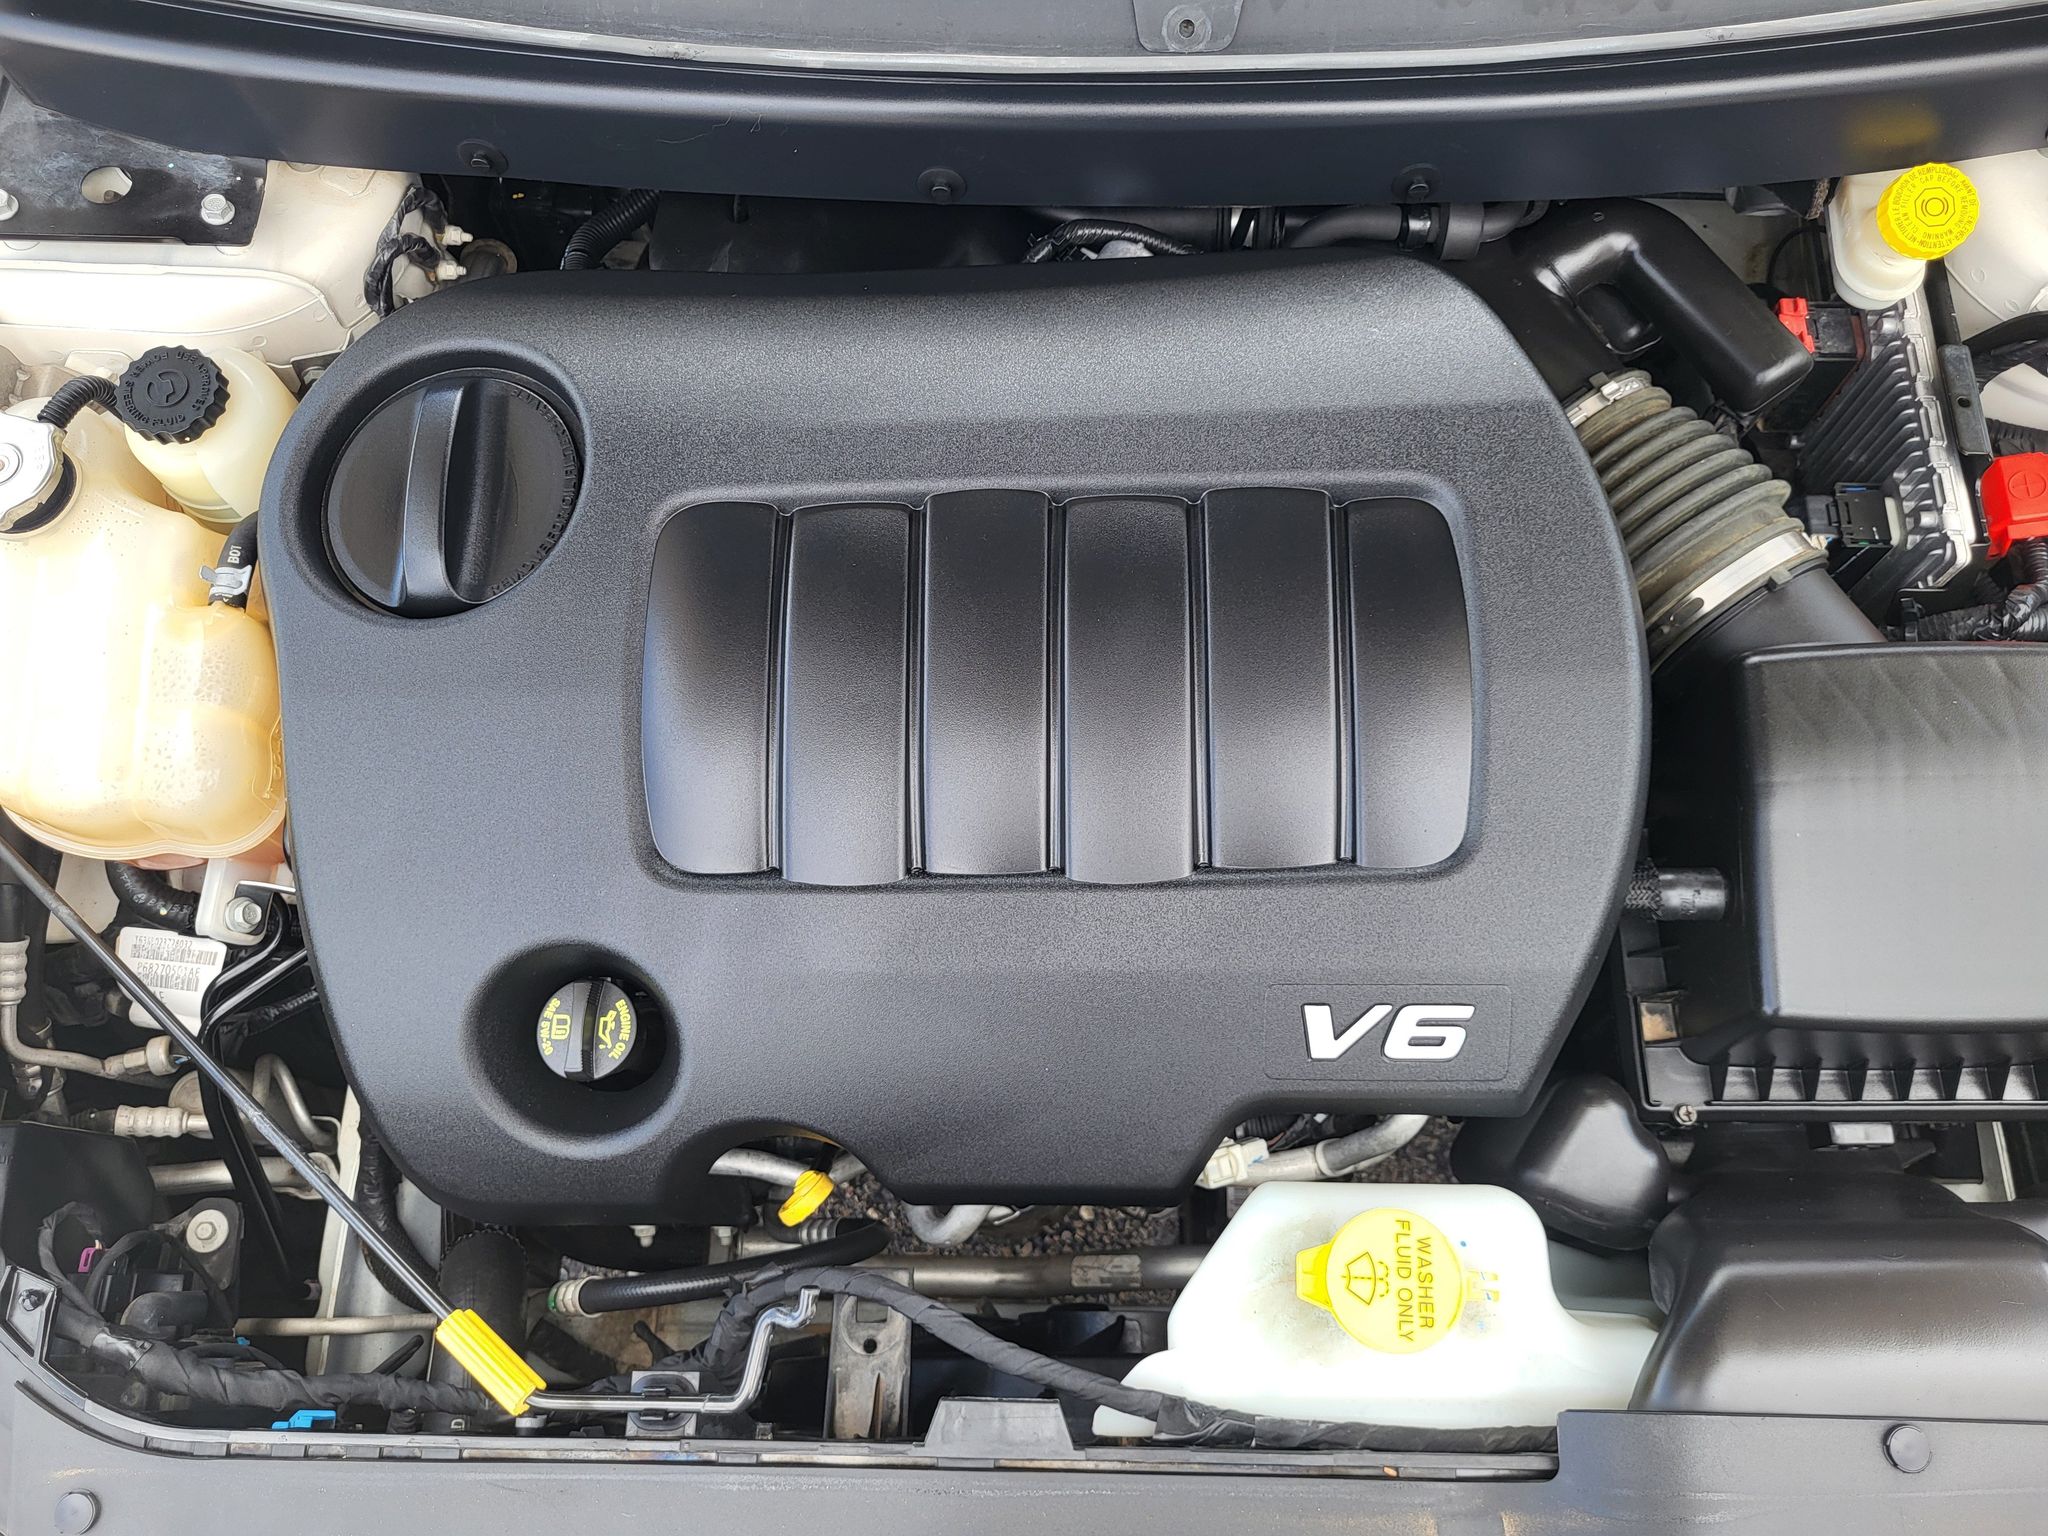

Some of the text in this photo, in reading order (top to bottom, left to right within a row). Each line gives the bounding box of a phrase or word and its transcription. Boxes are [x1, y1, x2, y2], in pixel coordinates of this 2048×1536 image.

[1920, 175, 1934, 184] CAP
[123, 380, 150, 424] STEERING
[152, 413, 186, 427] FLUID
[540, 998, 561, 1056] SAE 5W-20
[607, 999, 632, 1060] ENGINE OIL
[1300, 1002, 1476, 1063] V6
[1395, 1219, 1414, 1342] FLUID ONLY
[1416, 1236, 1435, 1329] WASHER
